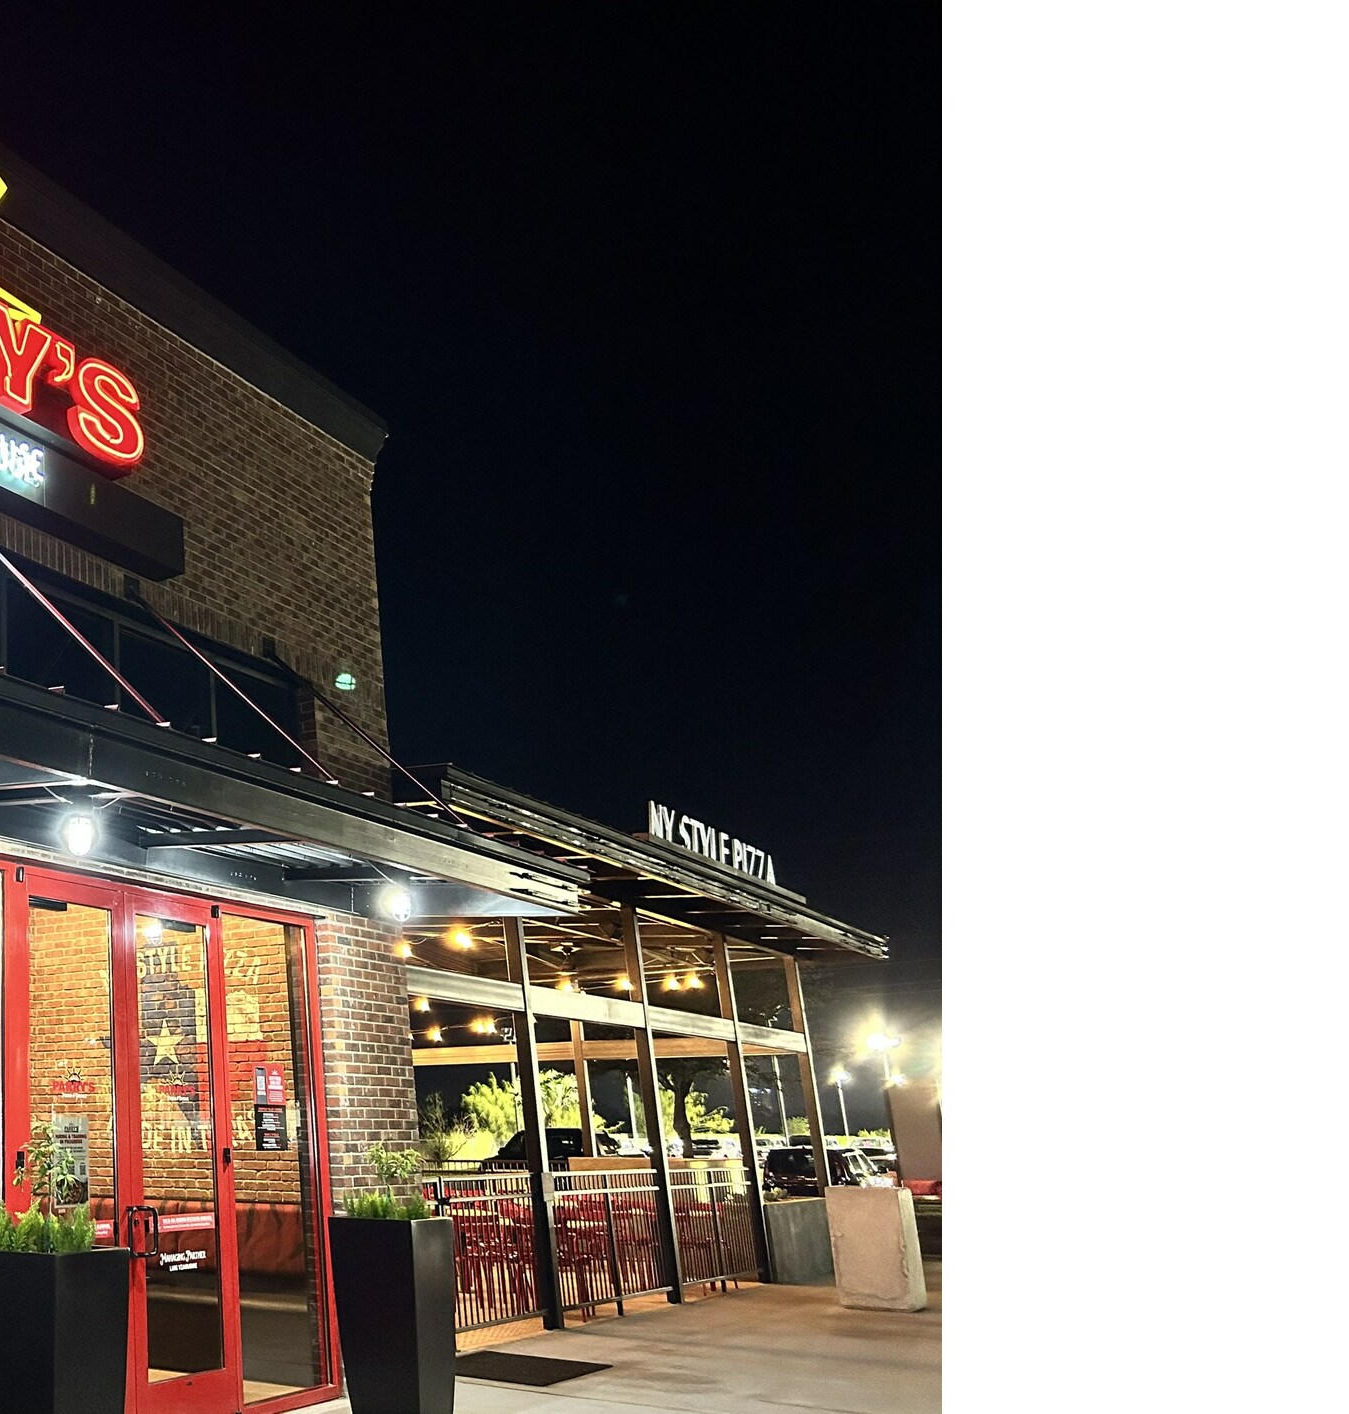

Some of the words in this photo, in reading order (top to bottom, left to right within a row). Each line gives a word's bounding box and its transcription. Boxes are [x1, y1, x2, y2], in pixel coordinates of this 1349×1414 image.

[648, 800, 675, 842] NY
[679, 815, 730, 866] STYLE
[731, 838, 776, 885] PIZZA
[136, 945, 192, 979] STYLE
[52, 1080, 95, 1092] PARRY'S
[171, 1125, 191, 1153] IN
